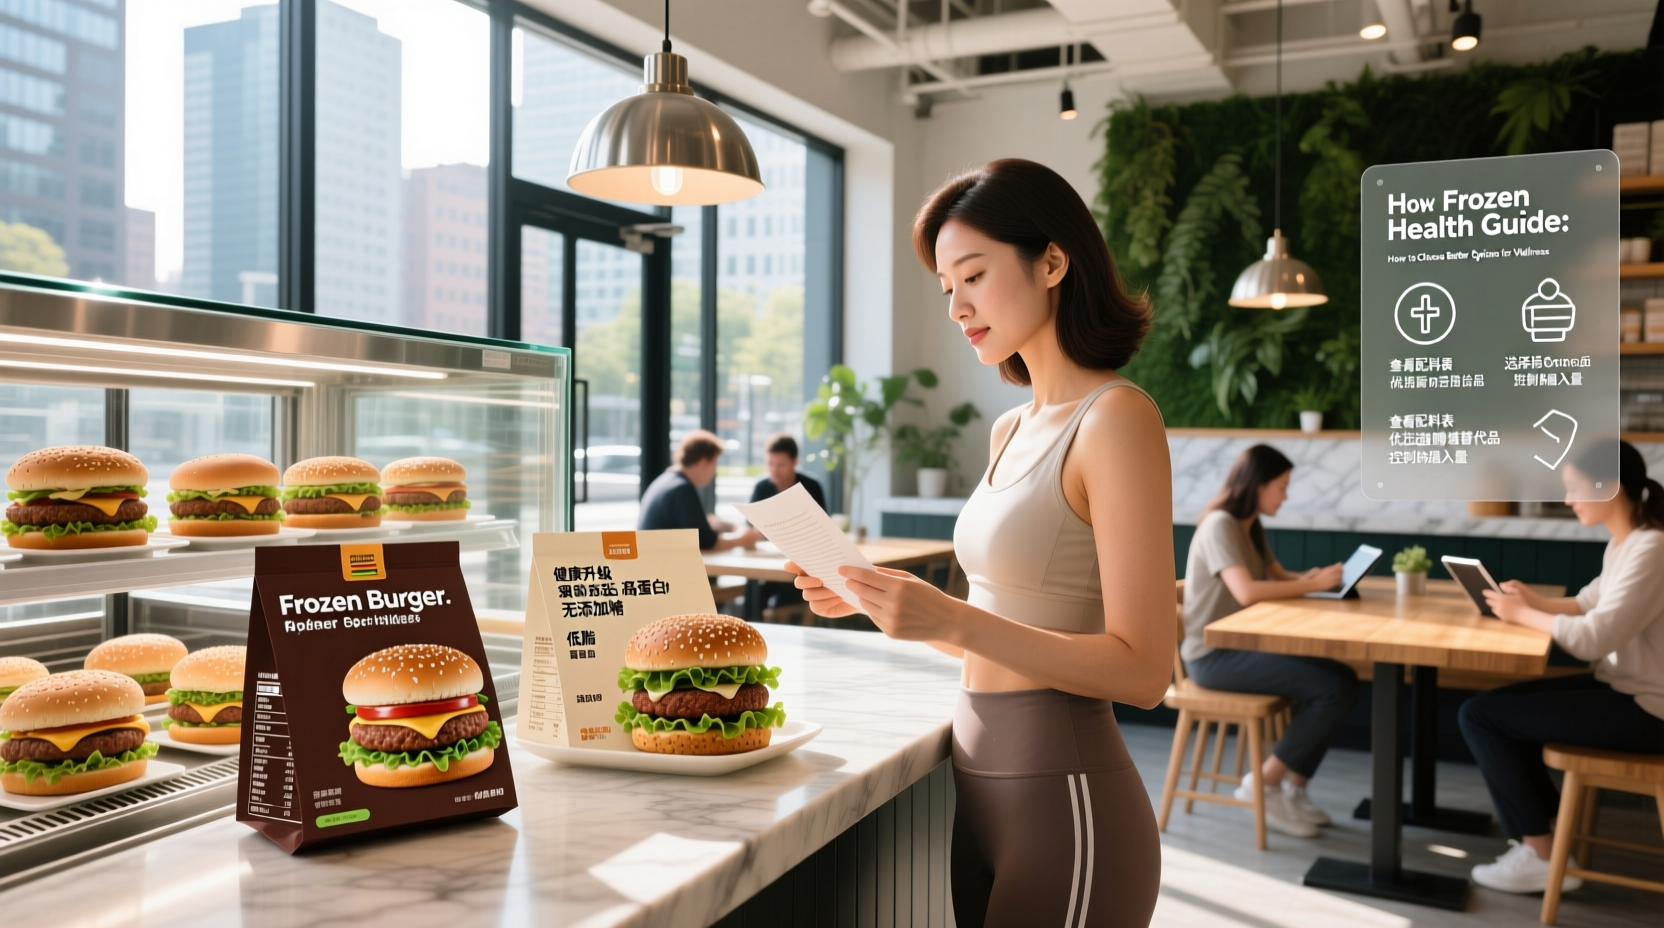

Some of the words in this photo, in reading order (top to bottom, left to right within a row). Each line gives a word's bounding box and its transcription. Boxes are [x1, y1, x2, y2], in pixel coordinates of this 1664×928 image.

[1388, 193, 1435, 215] How
[1443, 189, 1530, 212] Frozen
[1388, 214, 1474, 241] Health
[1481, 209, 1569, 236] Guide:
[554, 565, 612, 581] 健康升级
[279, 593, 363, 616] Frozen
[366, 589, 452, 613] Burger.
[562, 600, 624, 618] 无添加糖
